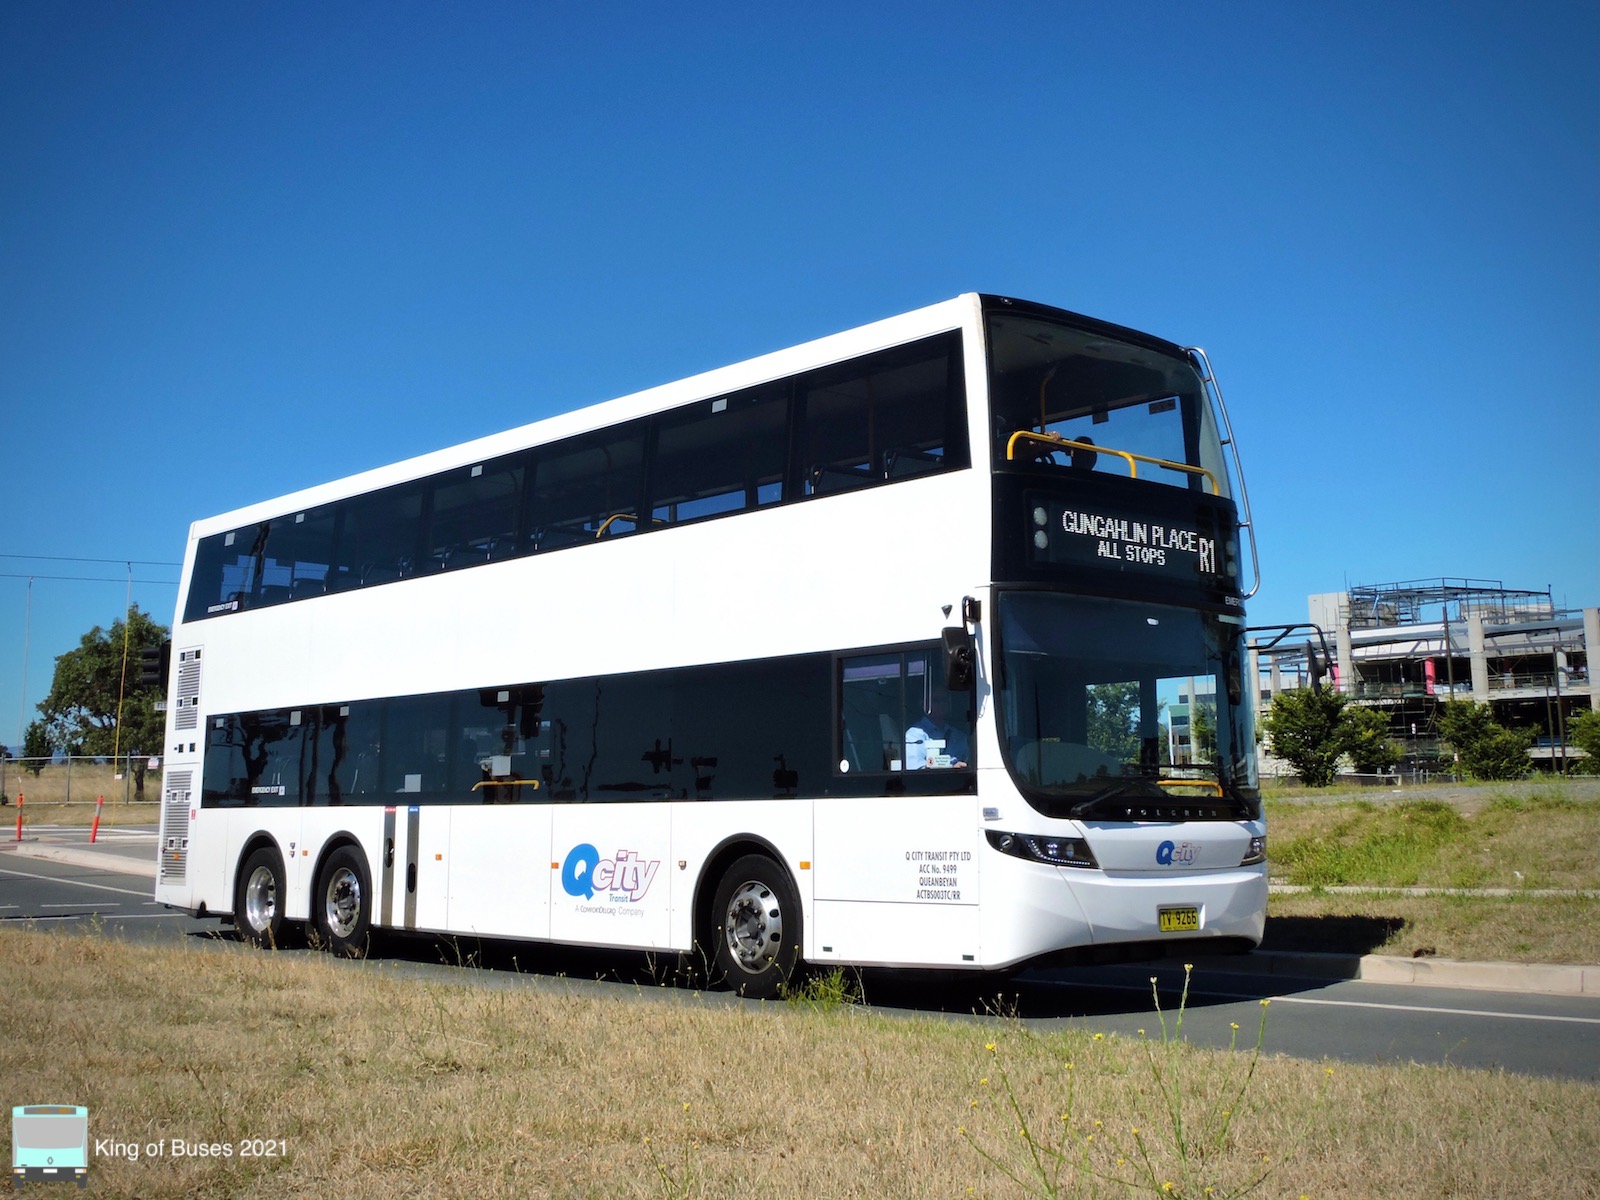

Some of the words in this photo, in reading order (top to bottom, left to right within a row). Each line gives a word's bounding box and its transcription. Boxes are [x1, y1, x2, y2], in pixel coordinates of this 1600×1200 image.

[1062, 510, 1148, 544] GUNGAHLIN
[1151, 525, 1198, 552] PLACE
[1198, 537, 1216, 573] R1
[1097, 540, 1122, 559] ALL
[1125, 544, 1166, 566] STOPS
[905, 851, 911, 861] Q
[911, 851, 924, 861] CITY
[924, 851, 947, 861] TRANSIT
[949, 851, 960, 861] PTY
[960, 851, 971, 861] LTD
[919, 864, 930, 874] ACC
[931, 865, 941, 874] No.
[942, 864, 957, 874] 9499
[919, 876, 958, 887] QUEANBEYAN
[609, 893, 628, 903] Transit
[1175, 910, 1197, 925] 9266
